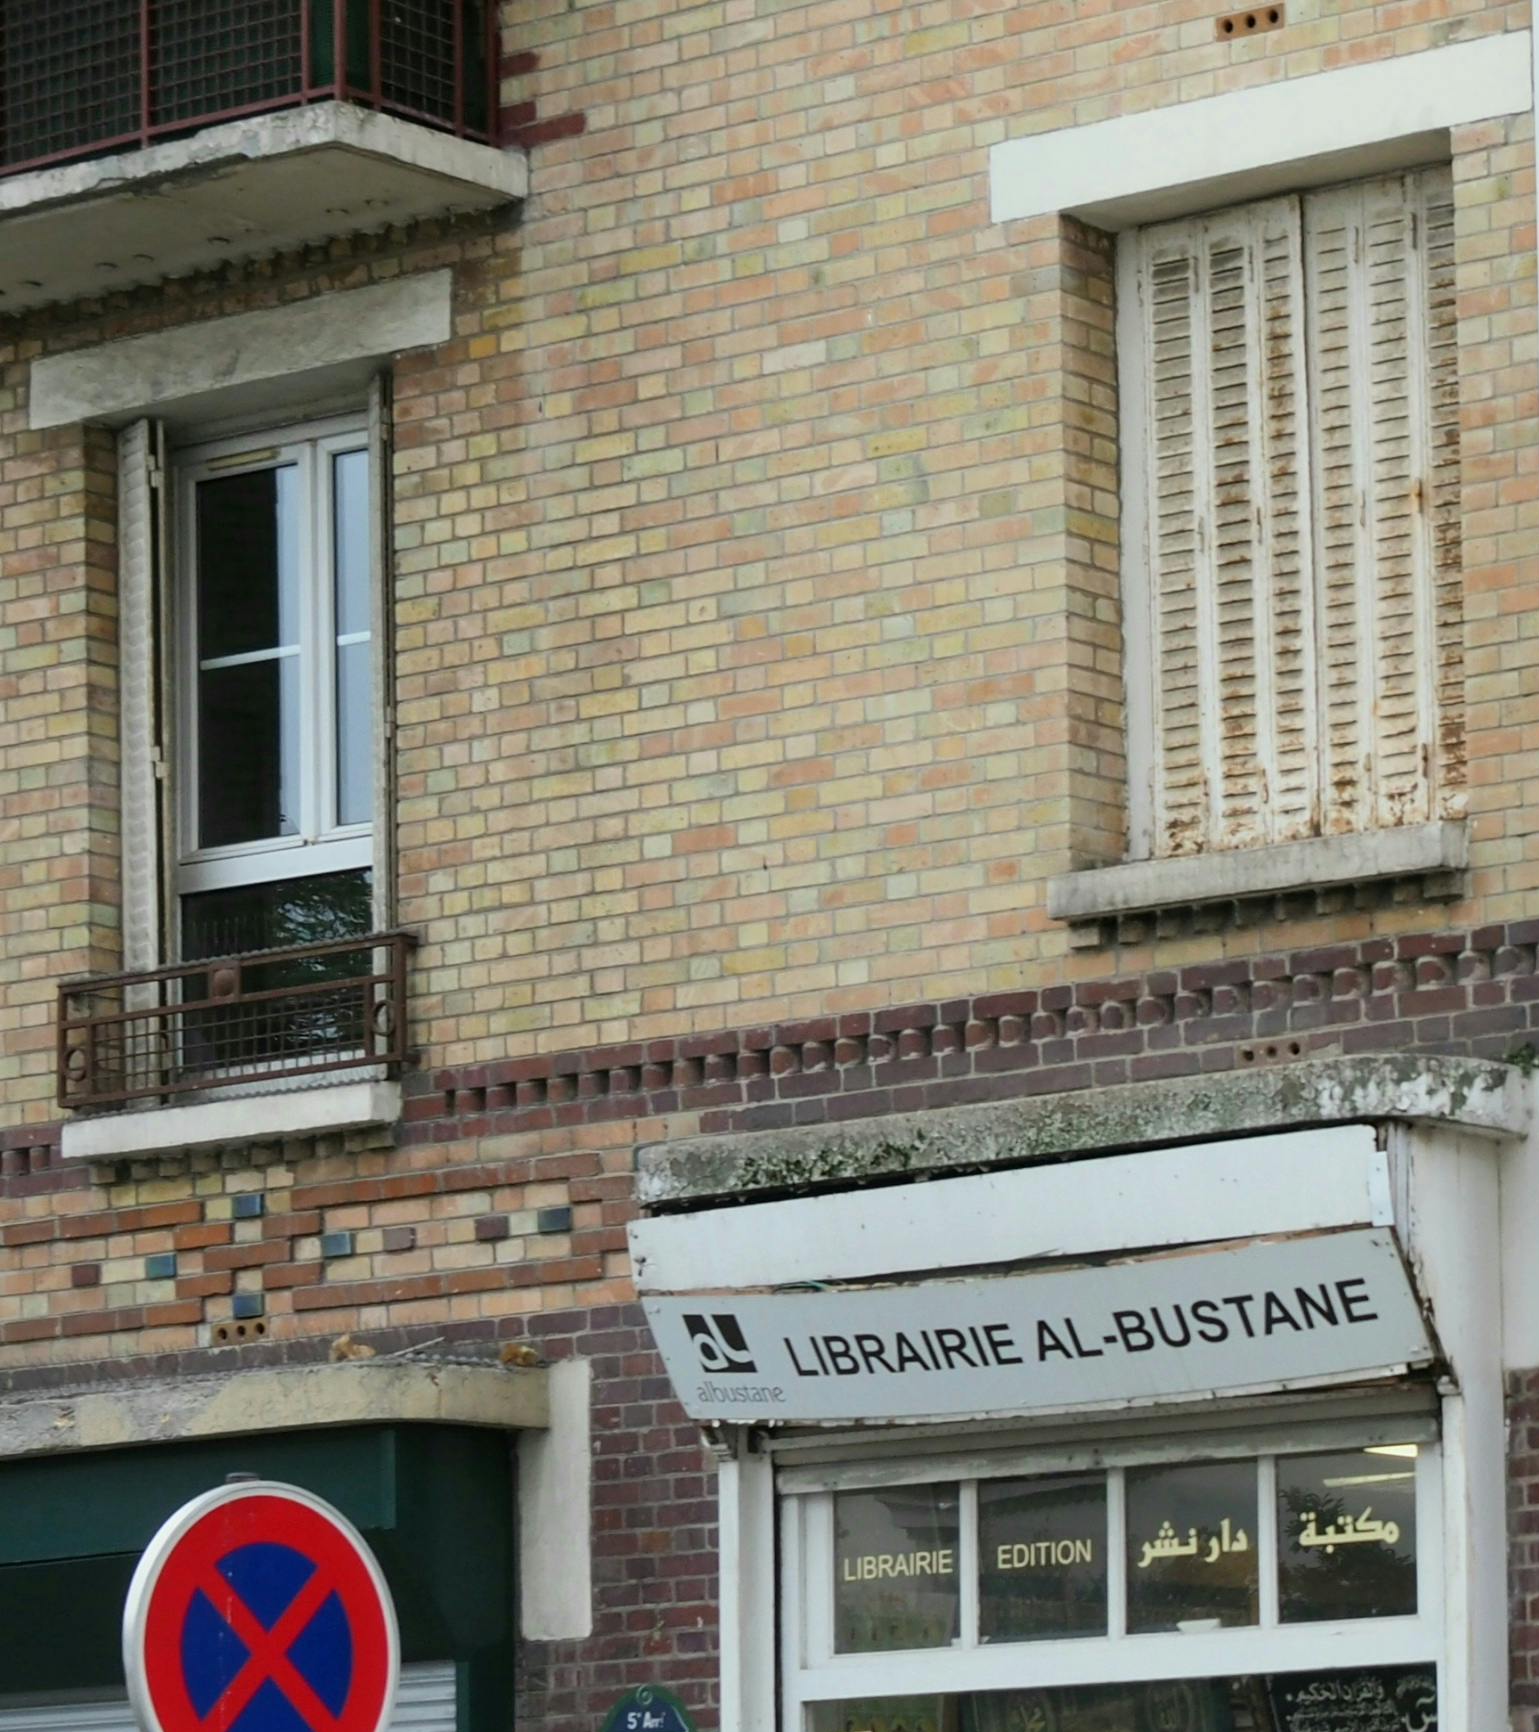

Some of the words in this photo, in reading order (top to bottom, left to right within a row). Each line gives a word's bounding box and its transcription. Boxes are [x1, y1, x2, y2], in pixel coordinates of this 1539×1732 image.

[783, 1323, 1023, 1377] LIBRAIRIE
[1036, 1277, 1379, 1362] AL-BUSTANE
[696, 1381, 785, 1404] albustane
[1137, 1520, 1198, 1568] نشر
[1204, 1517, 1248, 1563] دار
[1298, 1506, 1400, 1554] مكتبة
[843, 1549, 954, 1582] LIBRAIRIE
[996, 1539, 1093, 1570] EDITION
